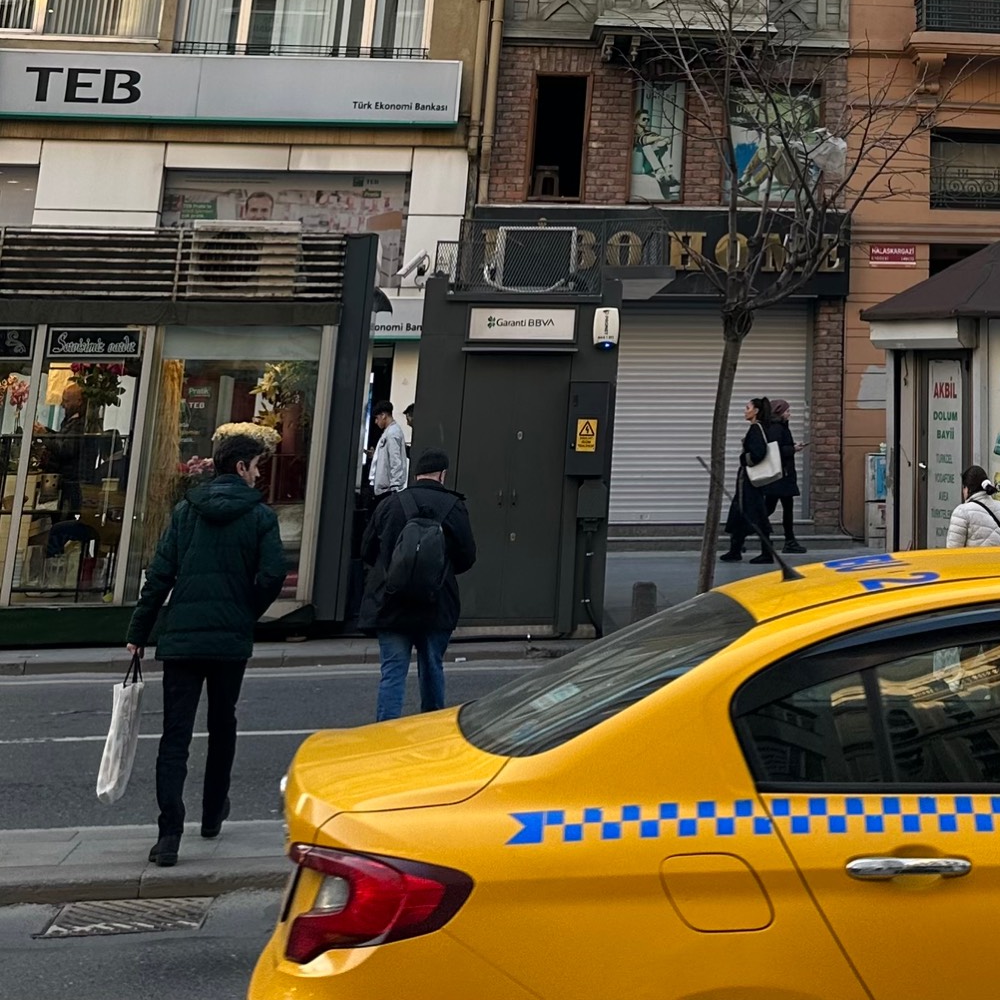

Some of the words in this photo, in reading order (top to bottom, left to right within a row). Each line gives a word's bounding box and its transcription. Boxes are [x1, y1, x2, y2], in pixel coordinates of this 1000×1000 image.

[26, 66, 142, 104] TEB
[352, 101, 372, 110] Türk
[374, 102, 413, 110] Ekonomi
[415, 103, 448, 111] Bankası
[497, 317, 526, 327] Garanti
[528, 318, 554, 327] BBVA
[933, 377, 957, 398] AKBİL
[933, 411, 958, 421] DOLUM
